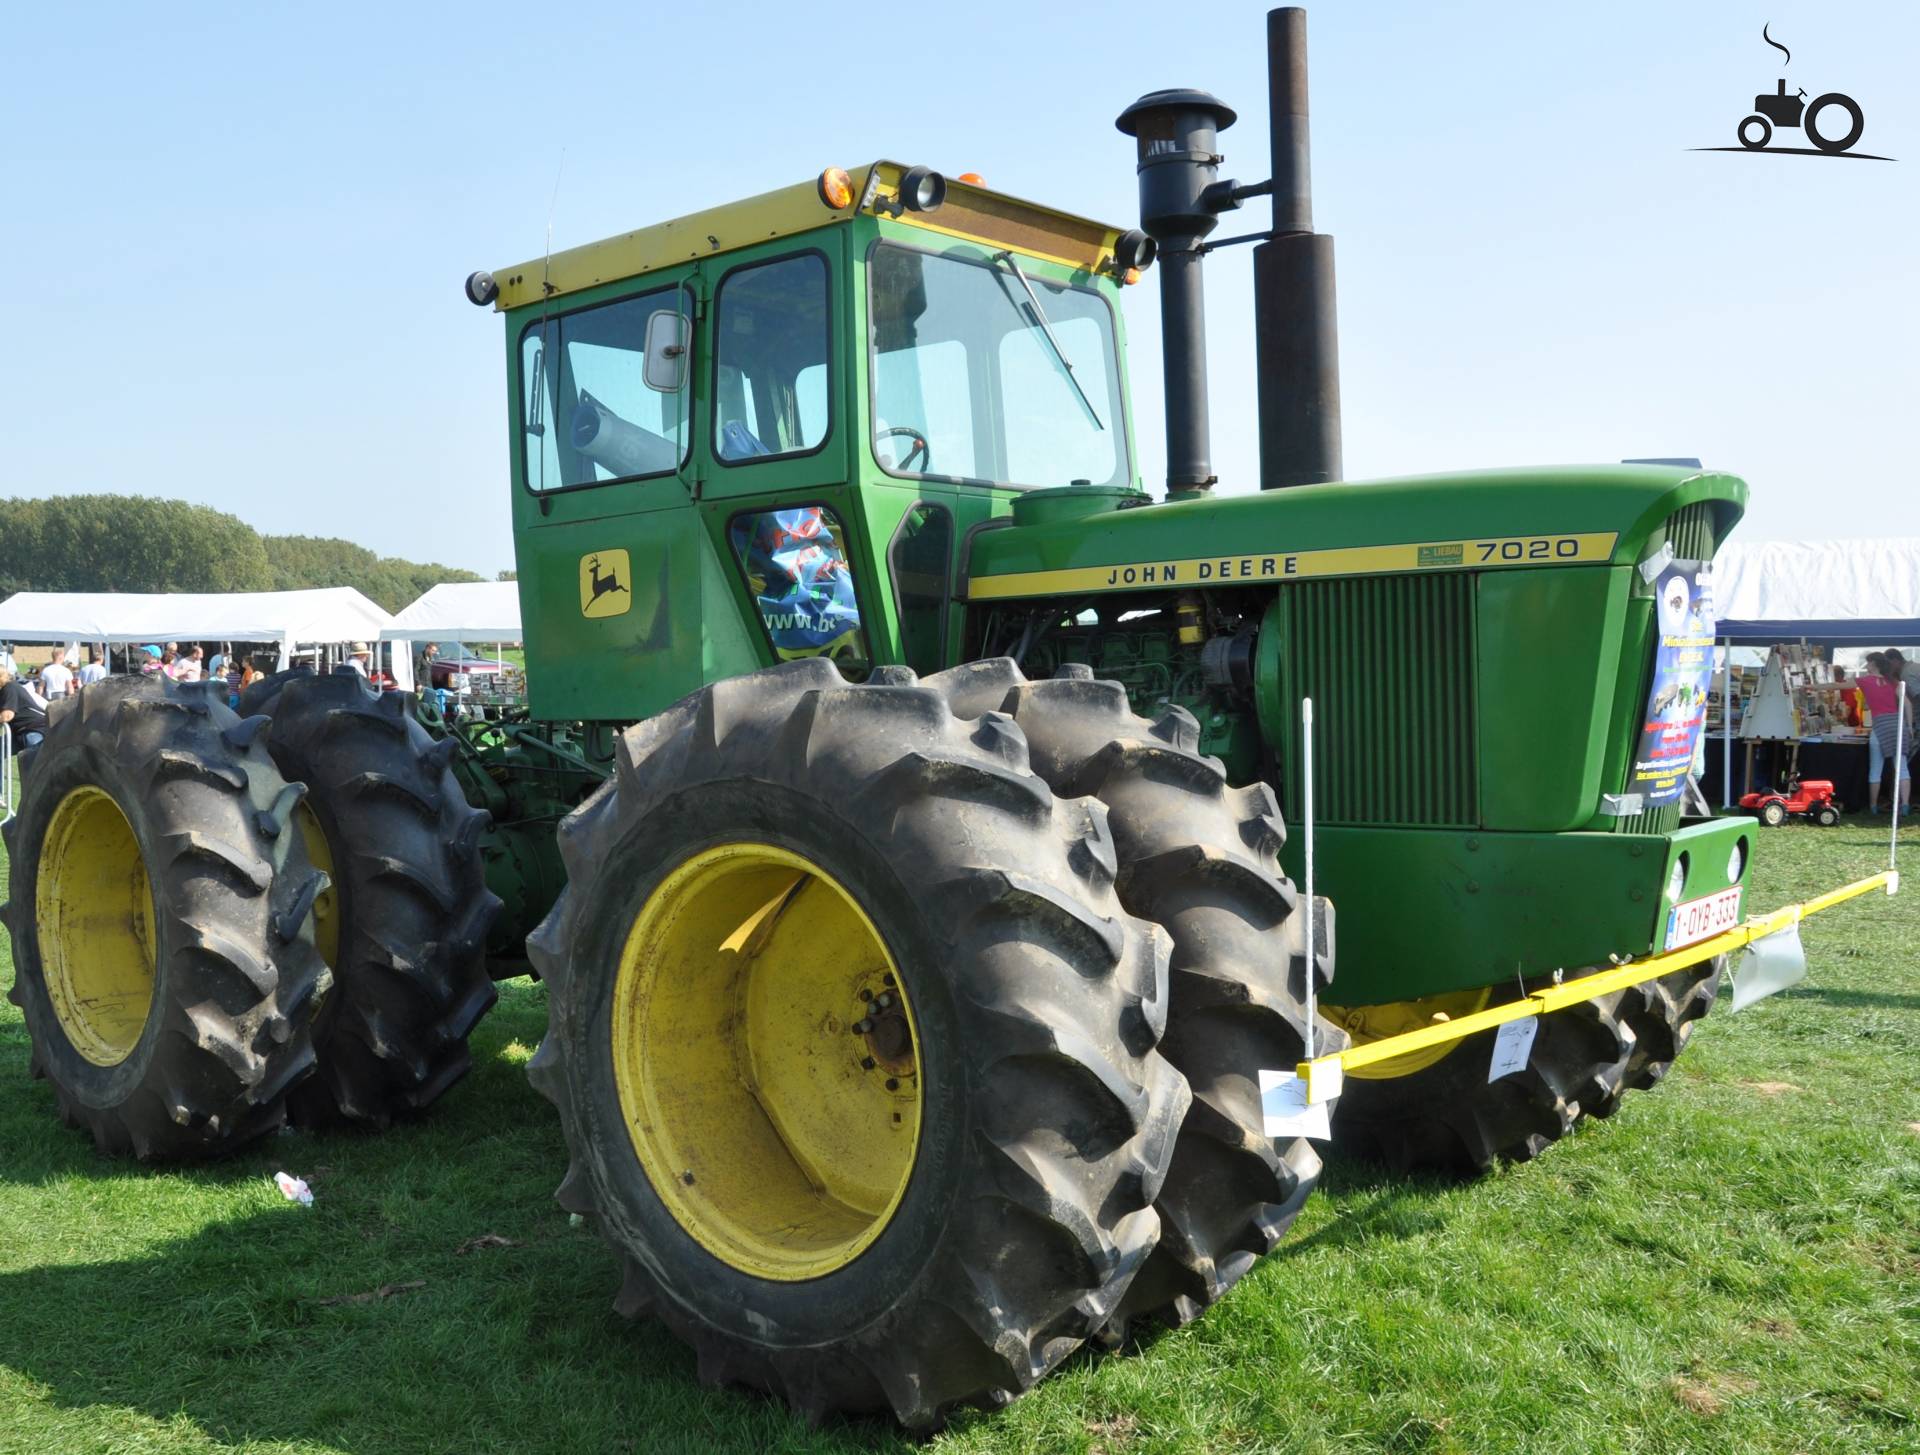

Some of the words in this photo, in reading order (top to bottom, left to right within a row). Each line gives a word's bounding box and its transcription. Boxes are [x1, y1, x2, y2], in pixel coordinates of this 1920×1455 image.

[1476, 539, 1579, 561] 7020
[1108, 565, 1176, 585] JOHN
[1199, 557, 1297, 579] DEERE
